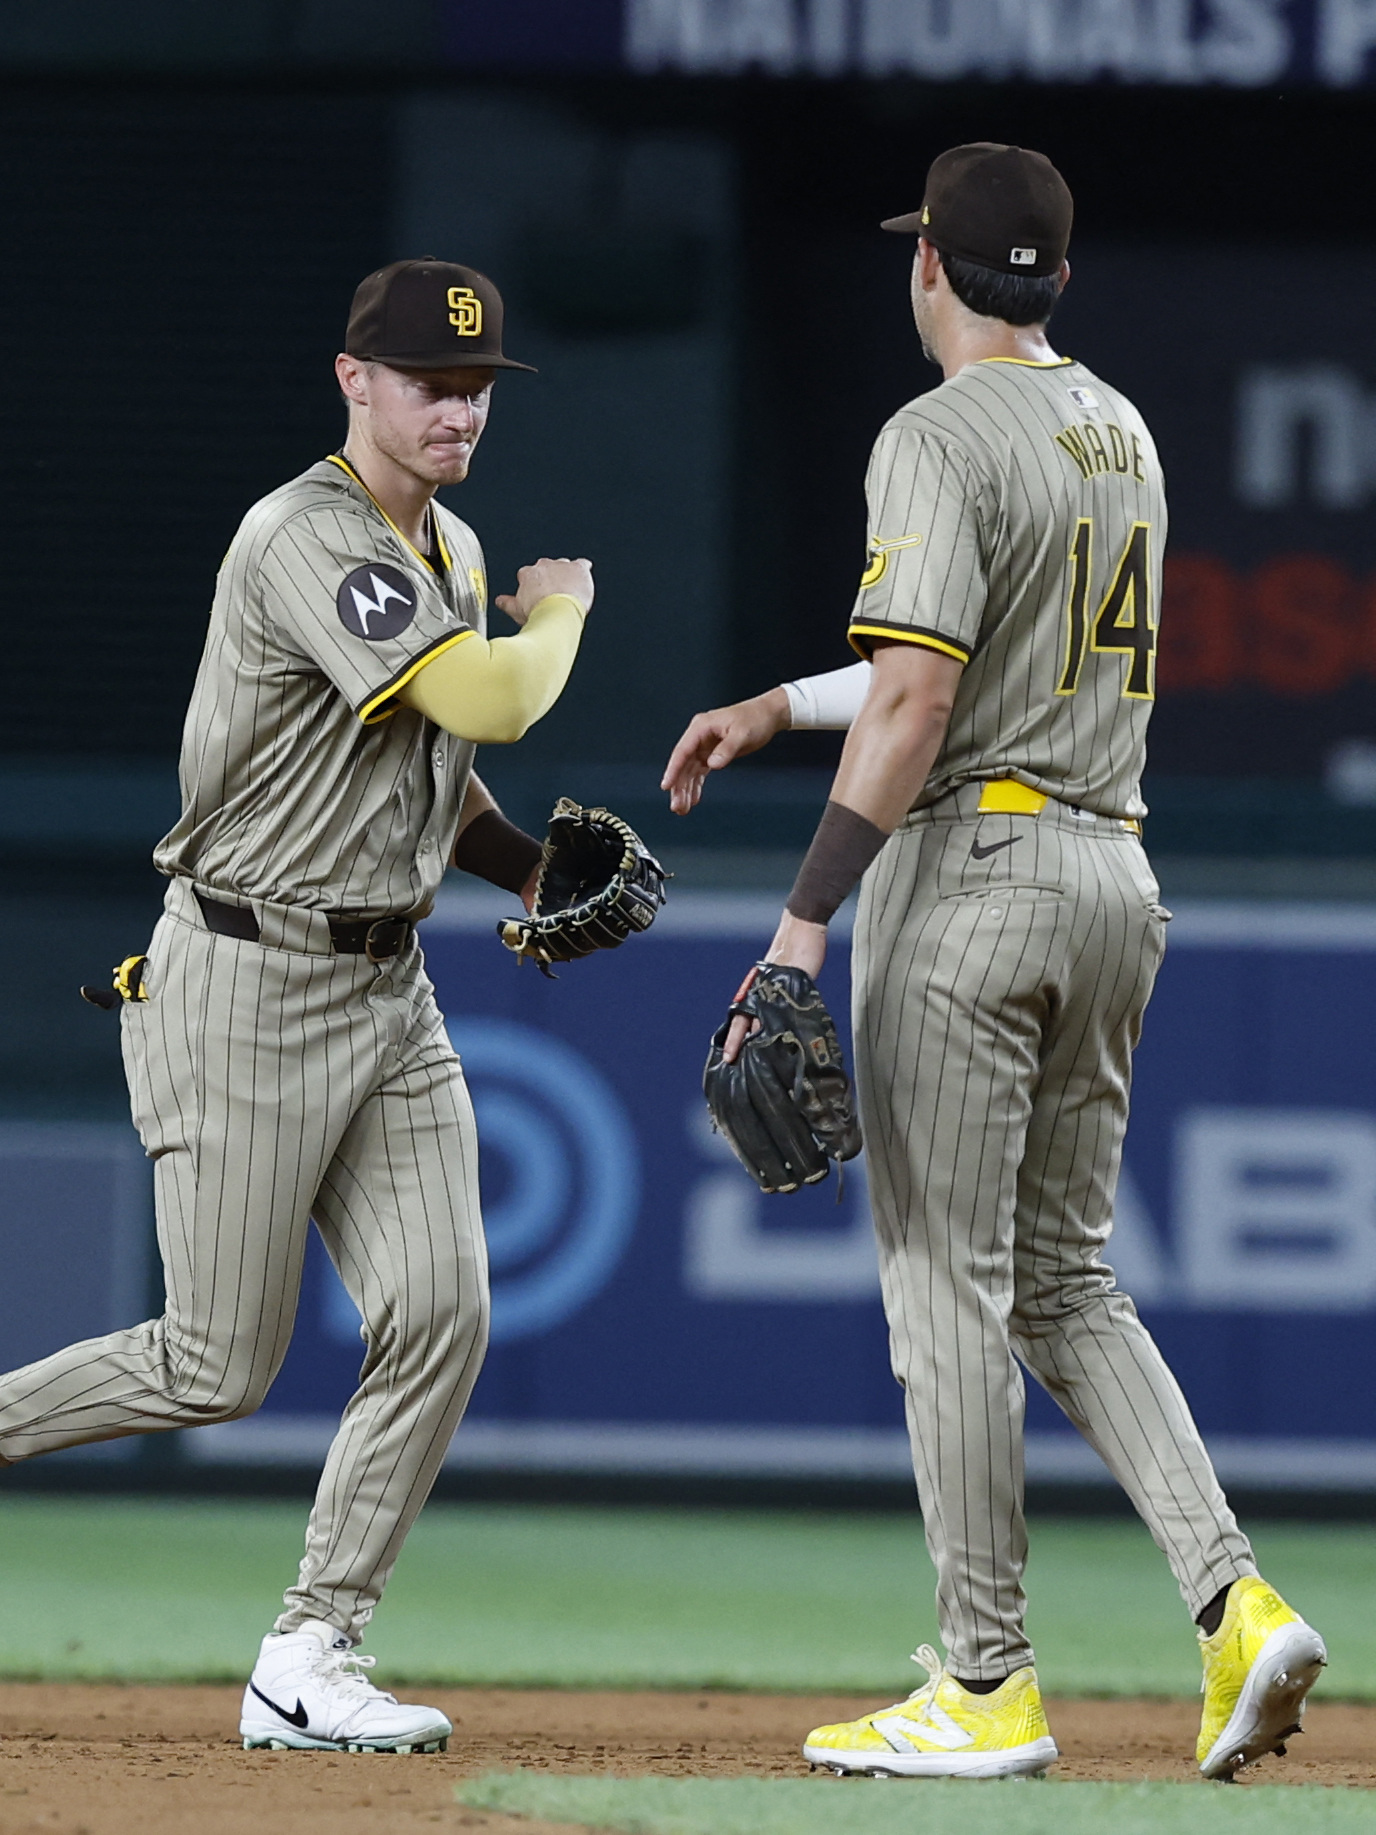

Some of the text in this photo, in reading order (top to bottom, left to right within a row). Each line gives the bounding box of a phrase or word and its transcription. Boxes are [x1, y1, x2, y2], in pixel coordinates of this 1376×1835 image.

[447, 286, 483, 337] SD
[1054, 422, 1146, 485] WADE
[1054, 517, 1157, 700] 14
